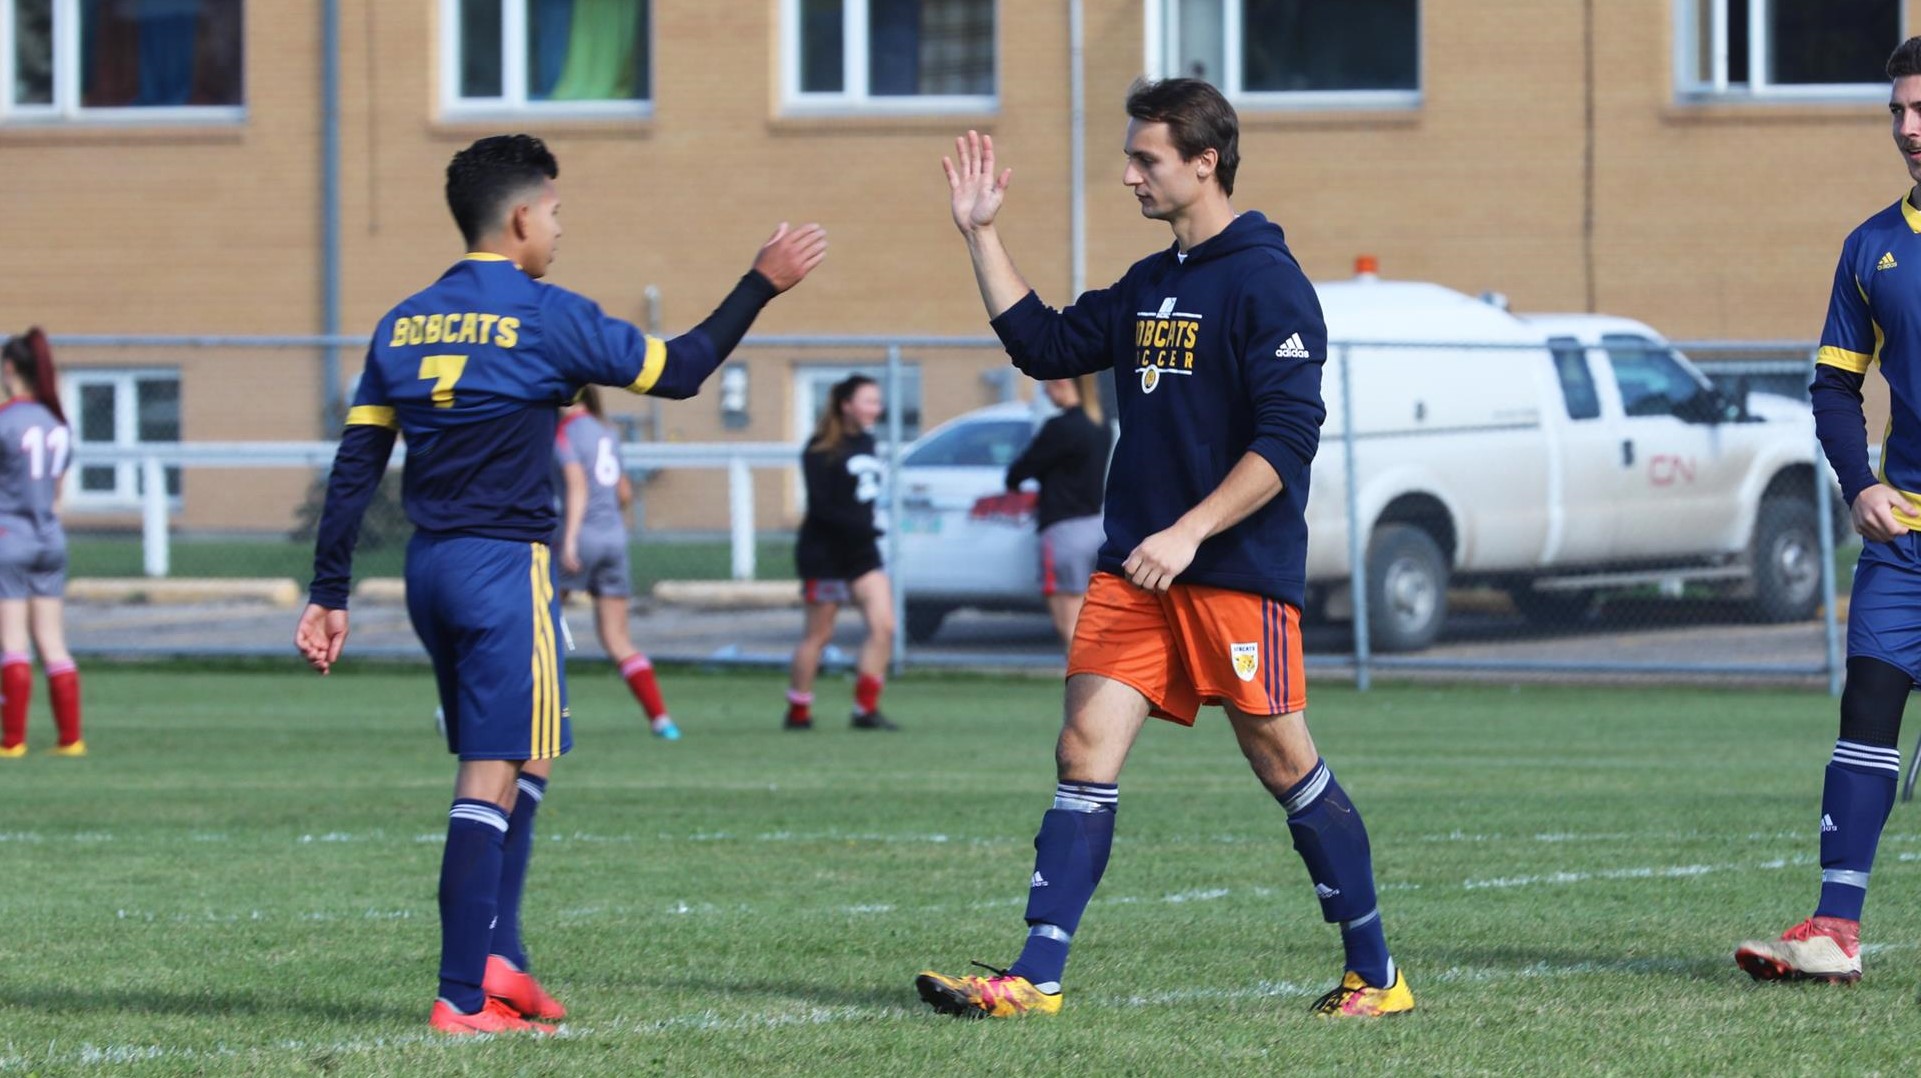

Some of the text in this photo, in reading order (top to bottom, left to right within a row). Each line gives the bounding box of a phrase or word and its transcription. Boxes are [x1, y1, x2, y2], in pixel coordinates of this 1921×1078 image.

[390, 313, 520, 348] BOBCATS
[1136, 320, 1199, 348] OBCATS
[1137, 349, 1194, 368] CCER
[1275, 348, 1309, 358] adidas
[418, 355, 469, 408] 7
[595, 437, 620, 487] 6
[1648, 454, 1697, 487] CN
